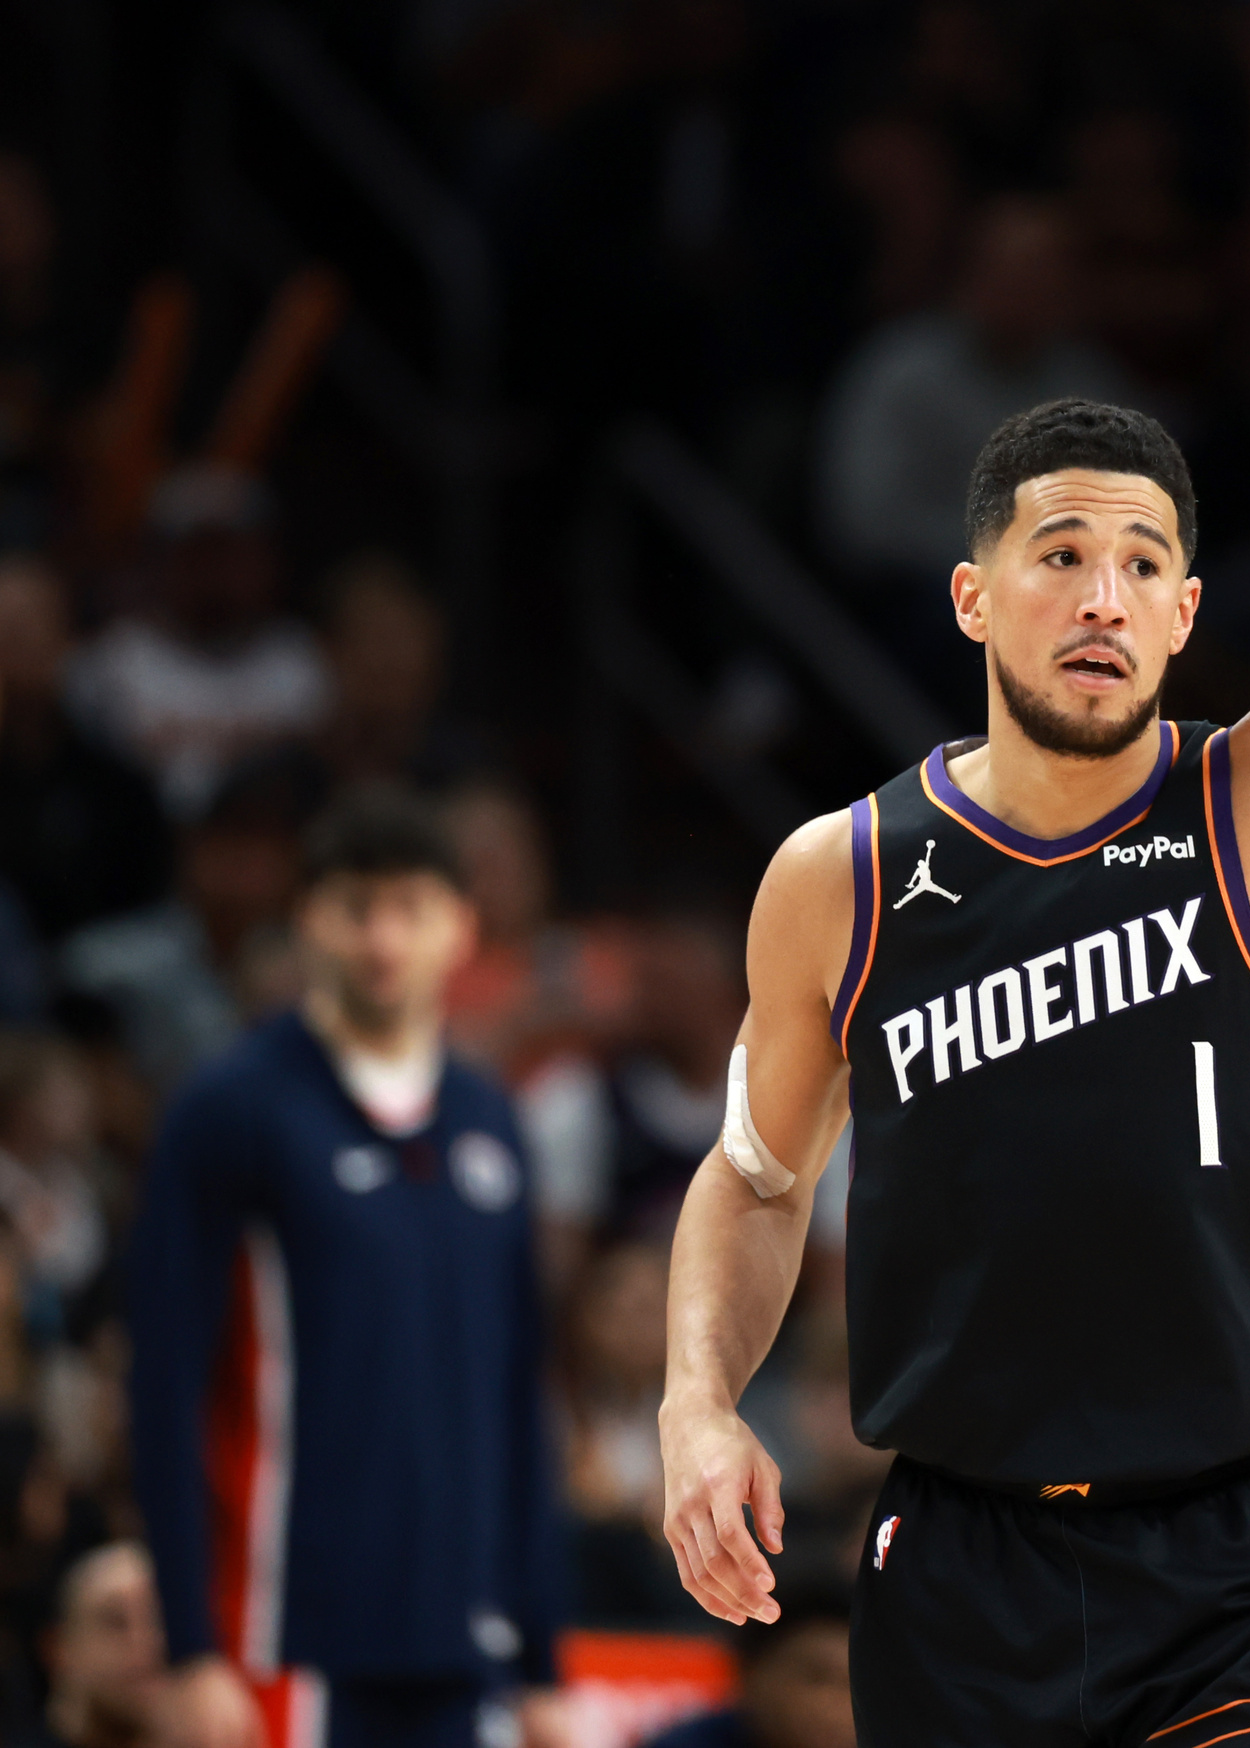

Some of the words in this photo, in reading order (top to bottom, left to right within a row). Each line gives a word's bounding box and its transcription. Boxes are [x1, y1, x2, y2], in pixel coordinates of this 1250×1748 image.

[1103, 835, 1196, 867] PayPal
[881, 896, 1213, 1104] PHOENIX
[1191, 1041, 1224, 1167] 1
